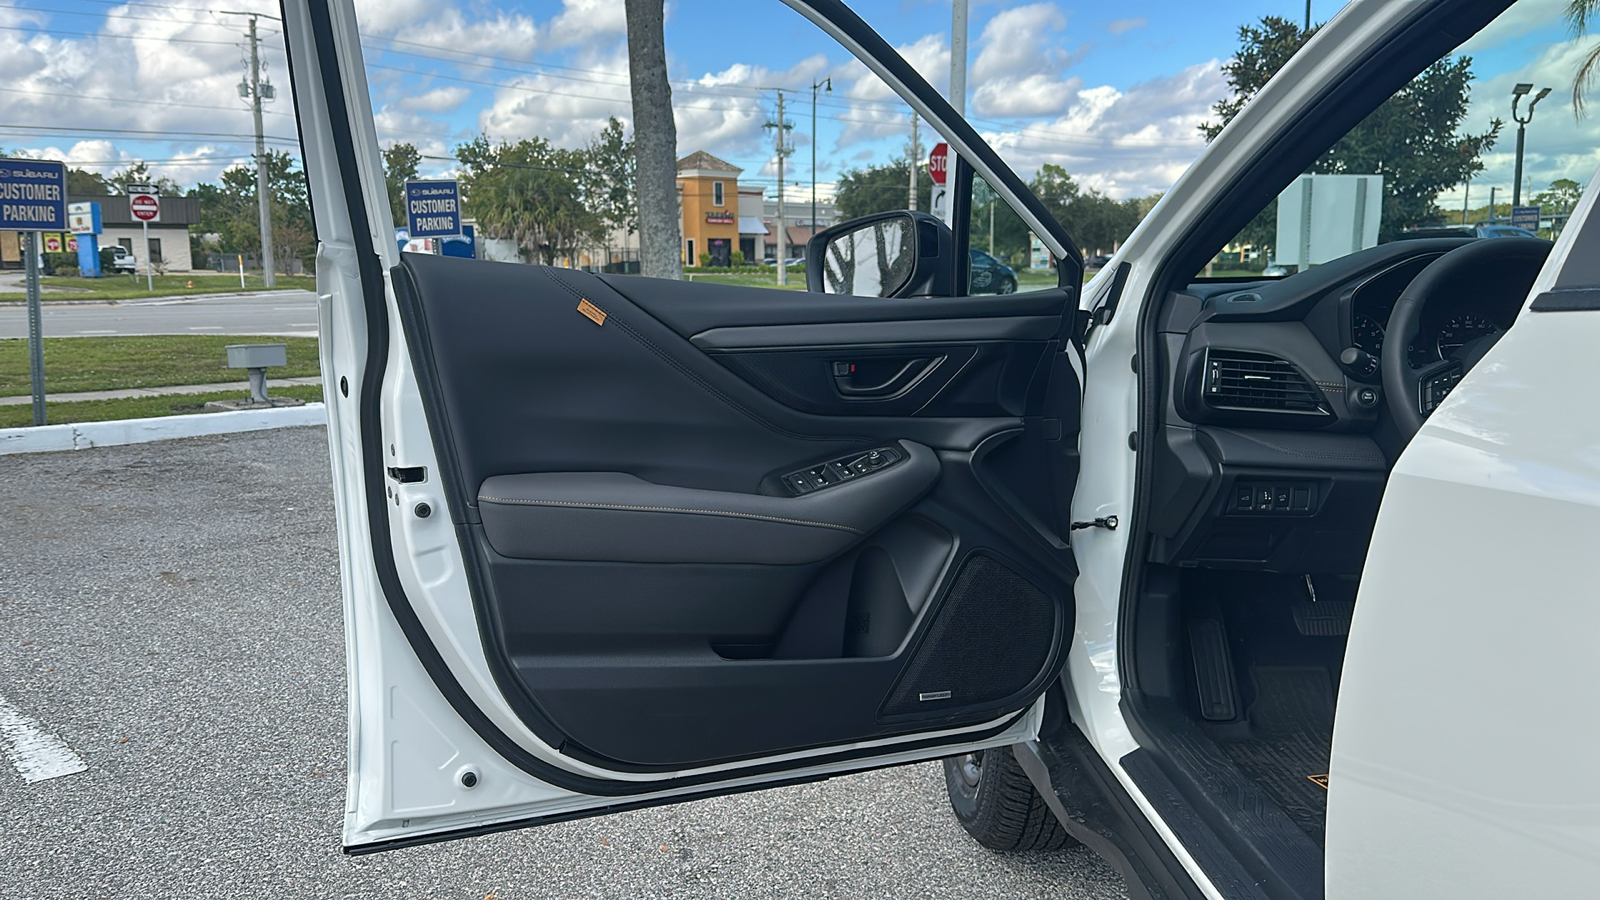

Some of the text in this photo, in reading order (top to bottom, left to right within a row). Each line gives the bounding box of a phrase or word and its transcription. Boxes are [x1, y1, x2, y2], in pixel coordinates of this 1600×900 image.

[930, 155, 947, 172] STO
[12, 170, 58, 179] SUBARU
[3, 204, 56, 222] PARKING
[411, 199, 456, 214] CUSTOMER
[416, 216, 453, 231] PARKING
